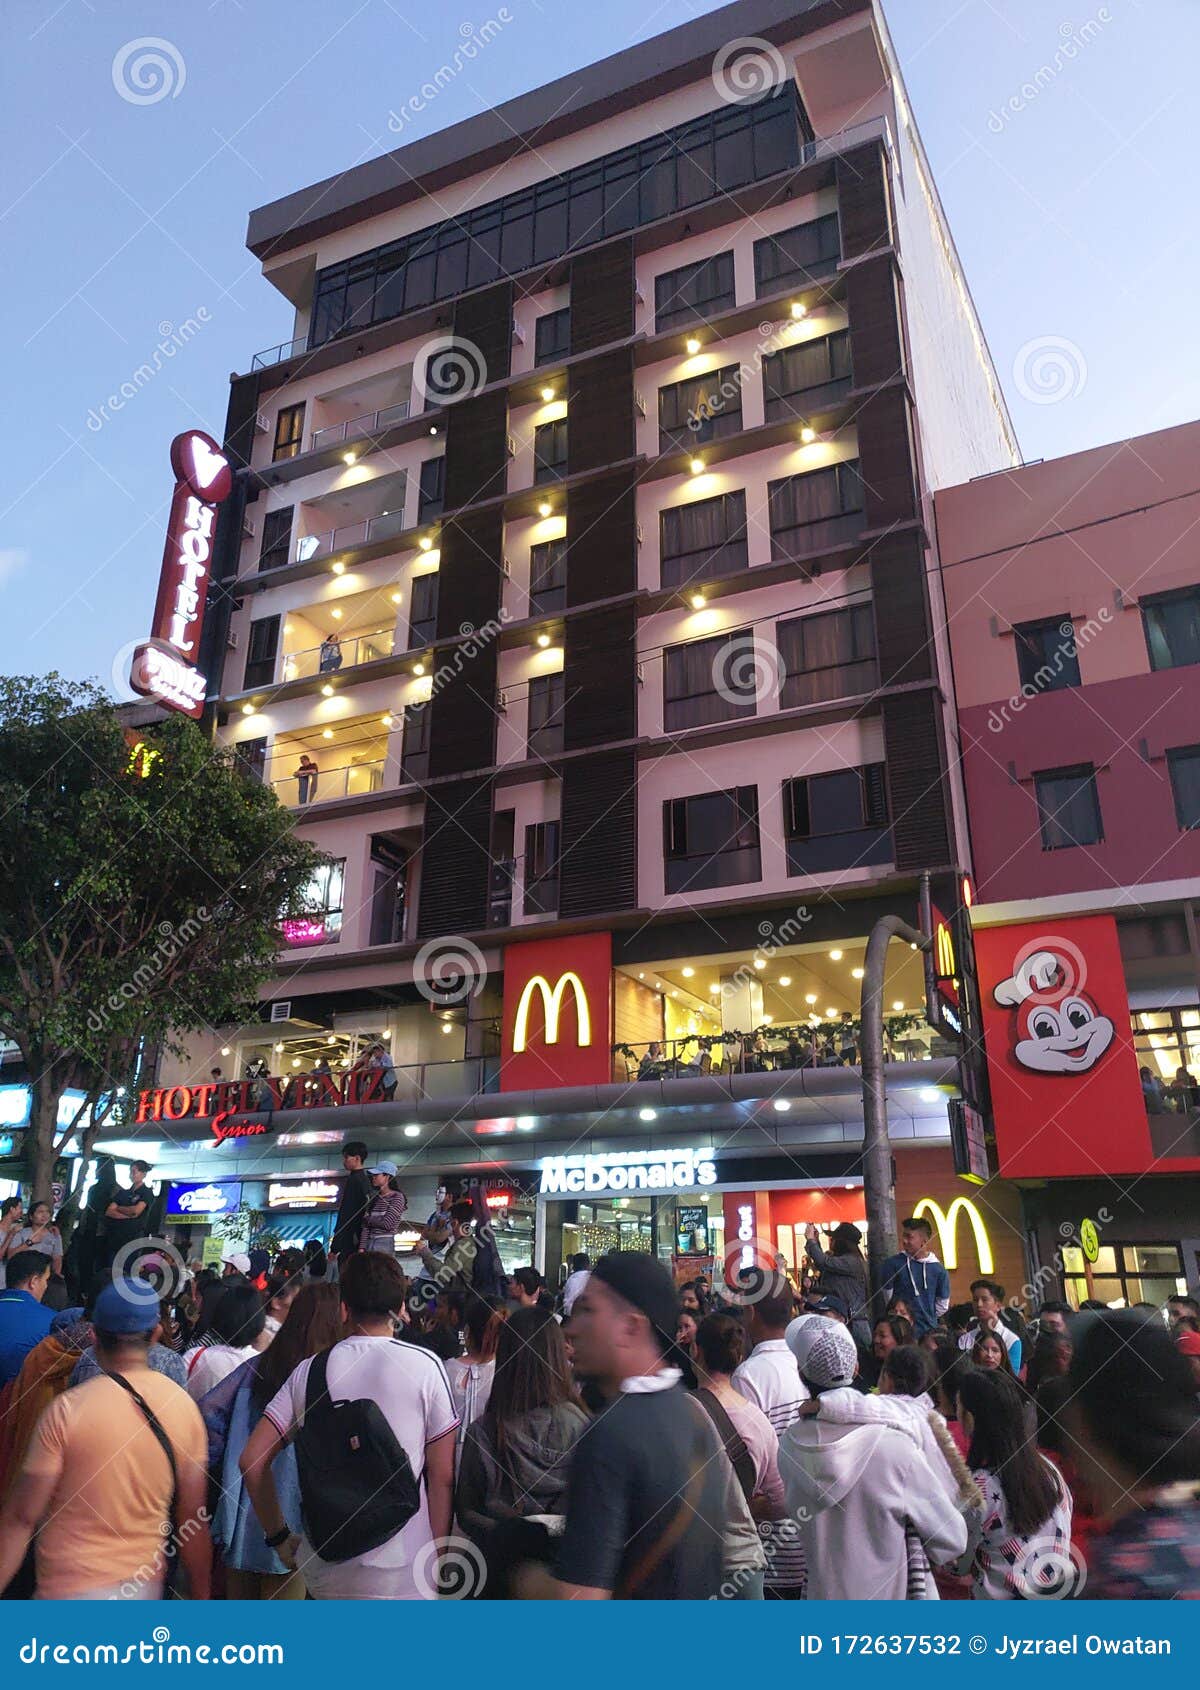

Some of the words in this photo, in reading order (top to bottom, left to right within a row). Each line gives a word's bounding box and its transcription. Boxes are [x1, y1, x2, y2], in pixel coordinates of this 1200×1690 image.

[169, 496, 214, 651] HOTEL
[136, 1080, 260, 1122] HOTEL
[267, 1069, 387, 1112] VENIZ
[539, 1161, 717, 1193] McDonald's
